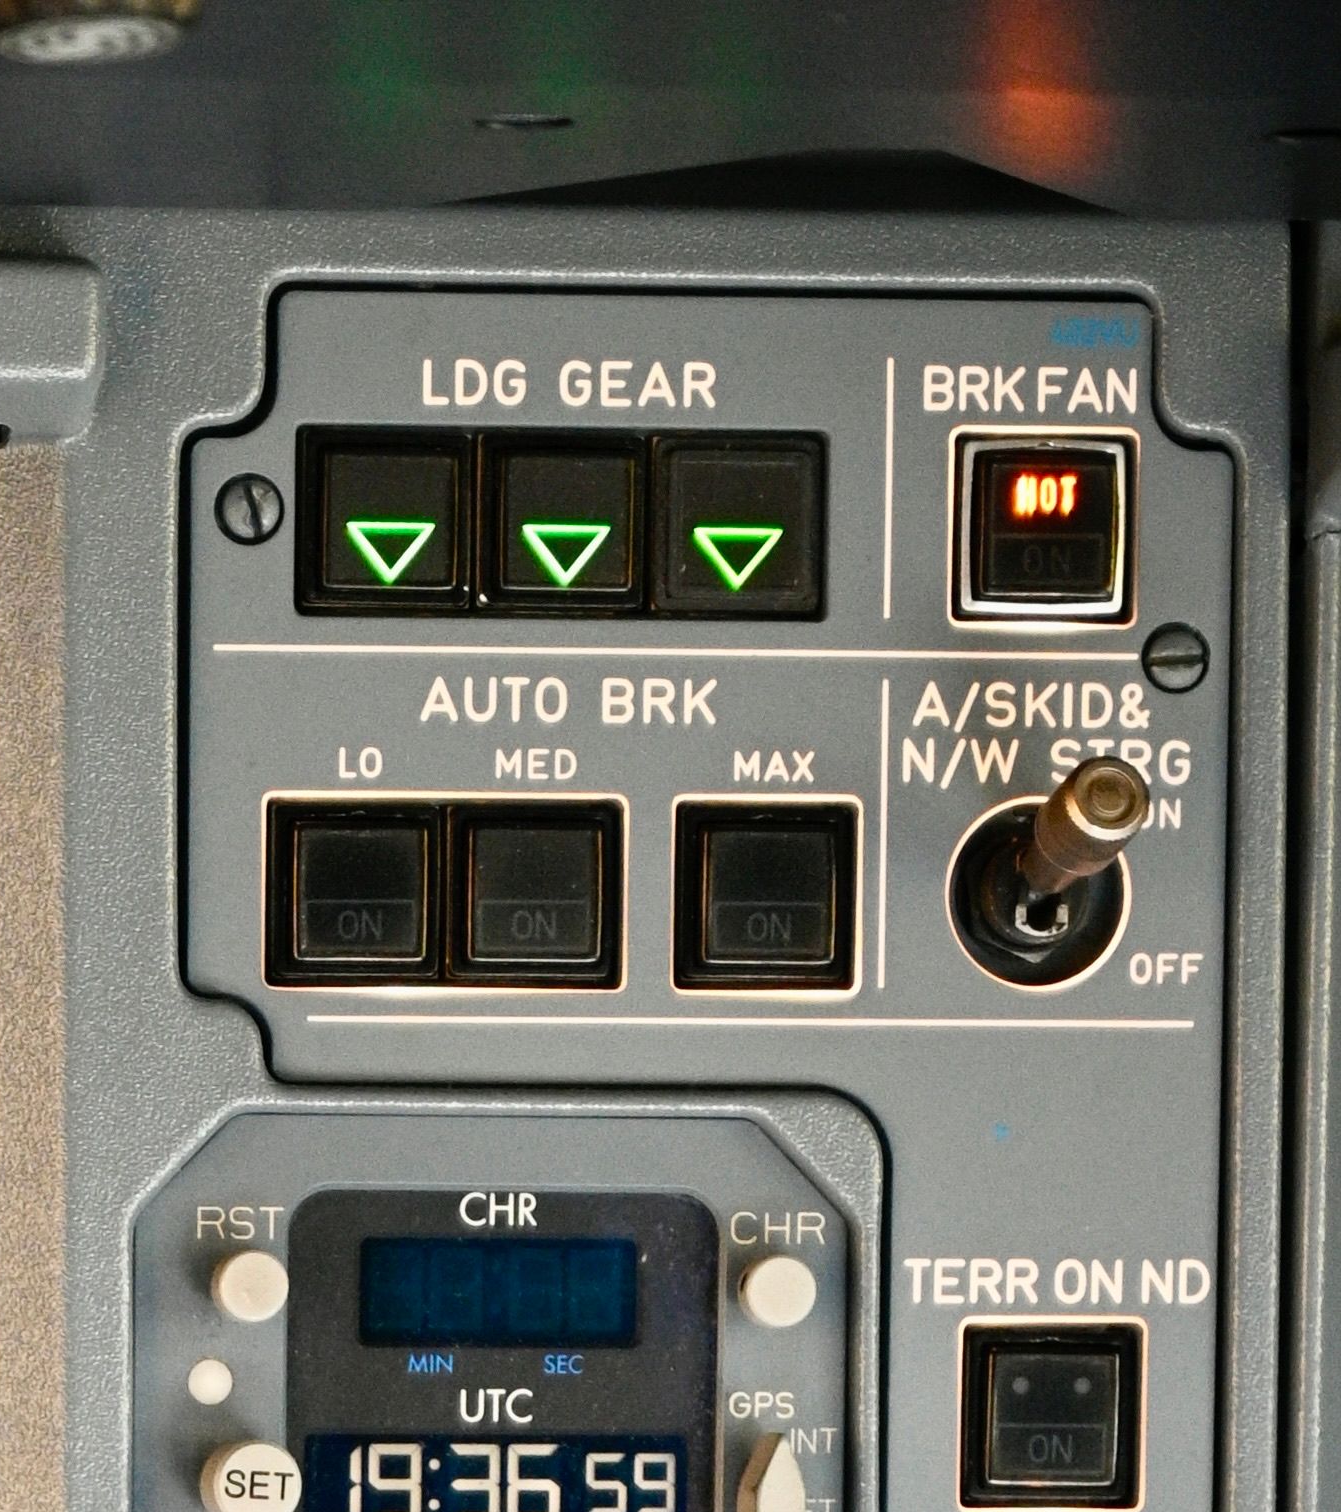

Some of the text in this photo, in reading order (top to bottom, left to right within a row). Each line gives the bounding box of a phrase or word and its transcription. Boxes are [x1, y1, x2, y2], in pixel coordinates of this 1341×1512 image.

[422, 358, 717, 409] LDG GEAR
[923, 364, 1138, 414] BRK FAN
[419, 675, 718, 726] AUTO BRK
[912, 680, 1151, 734] A/SKID&
[495, 748, 578, 780] MED
[733, 750, 815, 783] MAX
[901, 736, 1019, 790] N/W
[1129, 952, 1204, 985] OFF
[196, 1205, 286, 1241] RST
[459, 1191, 538, 1227] CHR
[730, 1211, 826, 1245] CHR
[903, 1257, 1211, 1305] TERR ON ND
[407, 1353, 454, 1374] MIN
[543, 1353, 584, 1375] SEC
[459, 1388, 534, 1425] UTC
[728, 1391, 795, 1420] GPS
[224, 1469, 294, 1501] SET
